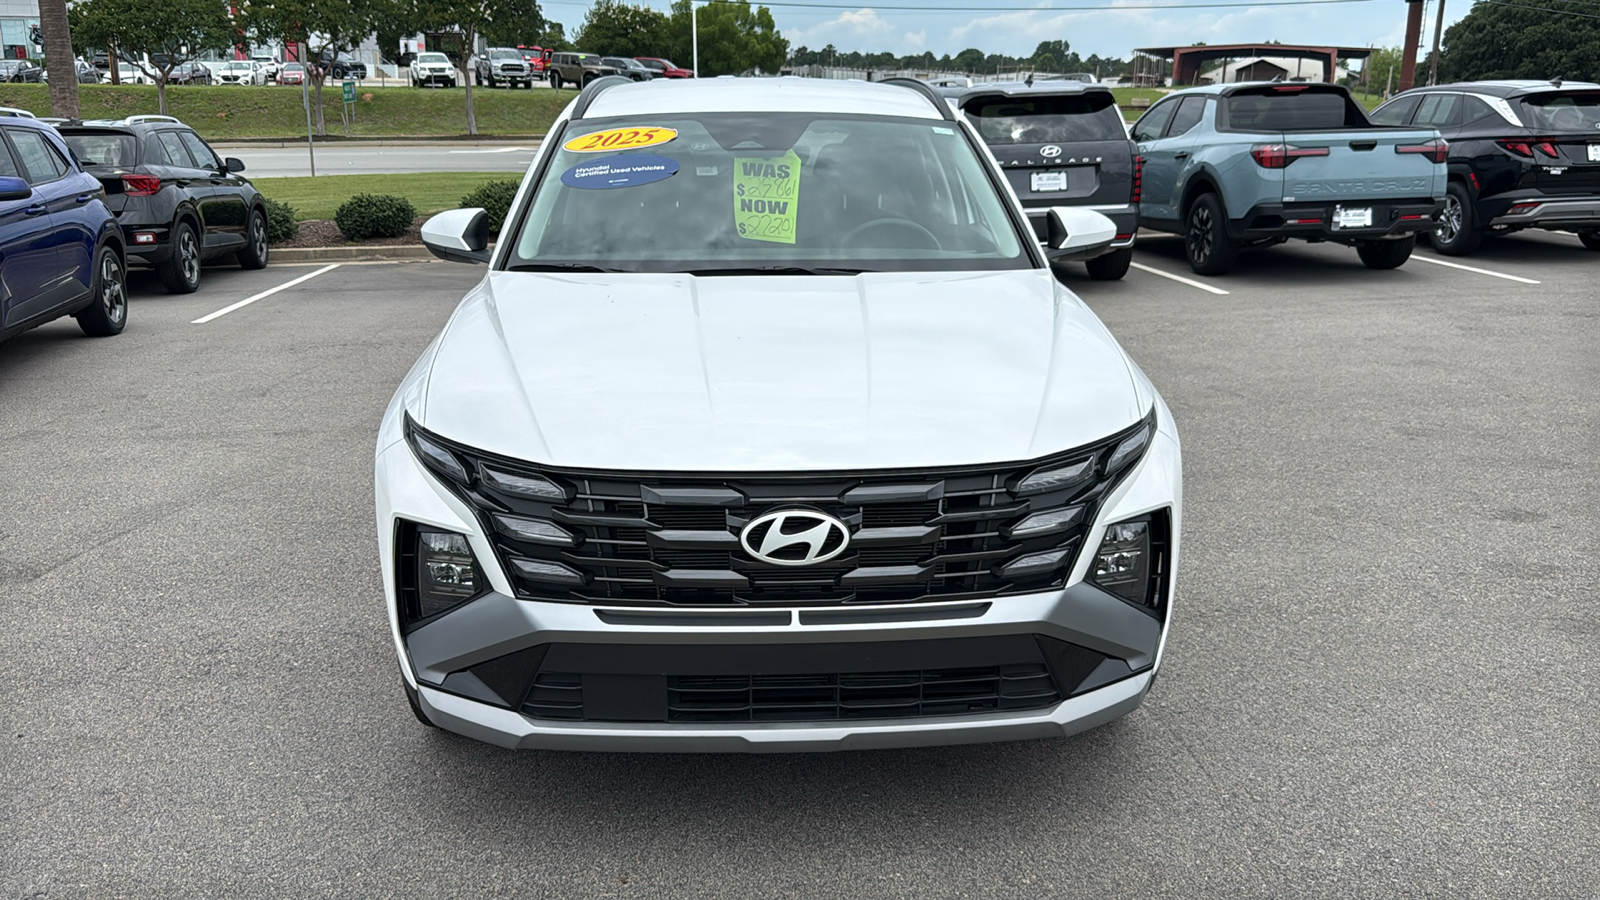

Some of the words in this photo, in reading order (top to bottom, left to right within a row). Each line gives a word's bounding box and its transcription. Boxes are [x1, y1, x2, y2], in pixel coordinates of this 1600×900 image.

[580, 129, 660, 150] 2025
[997, 157, 1102, 166] PALISADE
[575, 164, 610, 174] Hyundai
[575, 169, 609, 178] Certified
[610, 166, 631, 174] Used
[742, 162, 791, 179] WAS
[1293, 182, 1365, 194] SANTA
[1371, 180, 1426, 192] CRUZ
[740, 198, 789, 215] NOW
